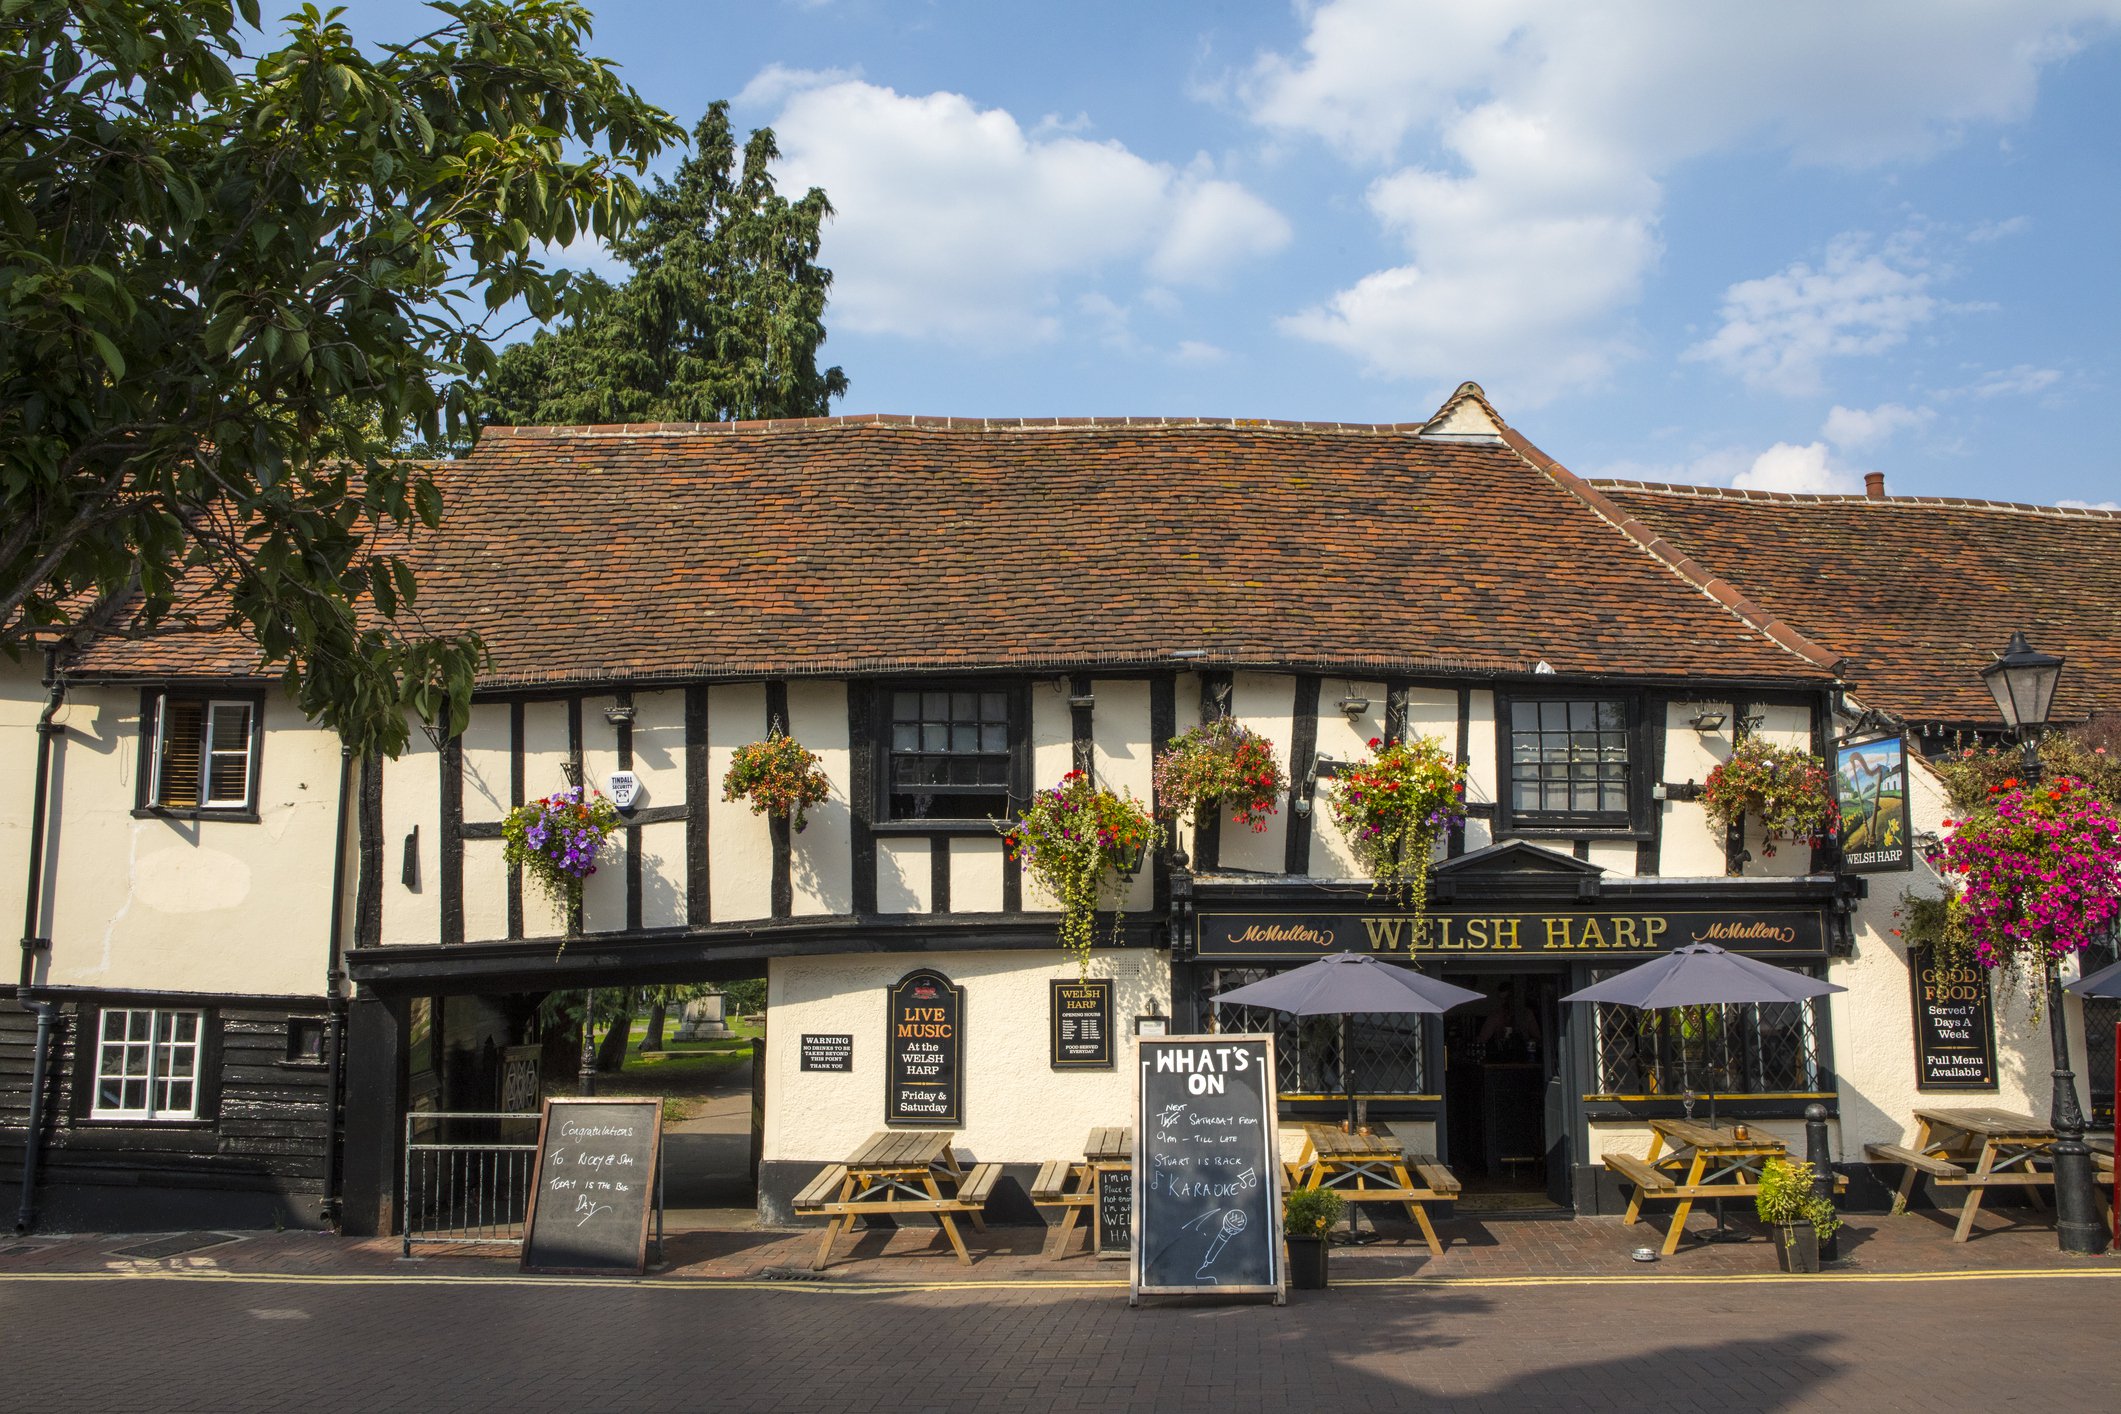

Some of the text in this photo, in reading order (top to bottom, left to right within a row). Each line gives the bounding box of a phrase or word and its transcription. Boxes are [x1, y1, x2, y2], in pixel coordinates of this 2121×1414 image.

[611, 776, 633, 784] TINDALL
[1845, 849, 1903, 865] WELSH HARP
[1228, 917, 1796, 950] McMullen WELSH HARP McMullen
[1922, 969, 1977, 984] GOOD
[1062, 990, 1100, 998] WELSH
[1925, 986, 1978, 1000] FOOD
[1067, 1001, 1097, 1009] HARP
[1929, 1005, 1975, 1015] Served 7
[904, 1008, 945, 1022] LIVE
[1934, 1018, 1972, 1028] Days A
[897, 1024, 952, 1038] MUSIC
[1938, 1030, 1970, 1039] Week
[907, 1043, 939, 1051] At the
[902, 1054, 944, 1063] WELSH
[1157, 1046, 1250, 1073] WHAT'S
[1927, 1056, 1984, 1065] Full Menu
[906, 1066, 939, 1075] HARP
[1930, 1068, 1982, 1077] Available
[1188, 1073, 1224, 1095] ON
[901, 1091, 947, 1102] Friday &
[900, 1103, 947, 1114] Saturday
[561, 1120, 633, 1143] Congratulations
[1194, 1134, 1212, 1143] TILL
[1220, 1135, 1238, 1143] LATE
[1154, 1153, 1242, 1167] STUART IS BACK
[1104, 1174, 1118, 1183] I'm
[585, 1181, 594, 1190] IS
[1169, 1173, 1240, 1198] KARAOKE
[1102, 1212, 1132, 1226] WEL
[1110, 1229, 1129, 1242] HA
